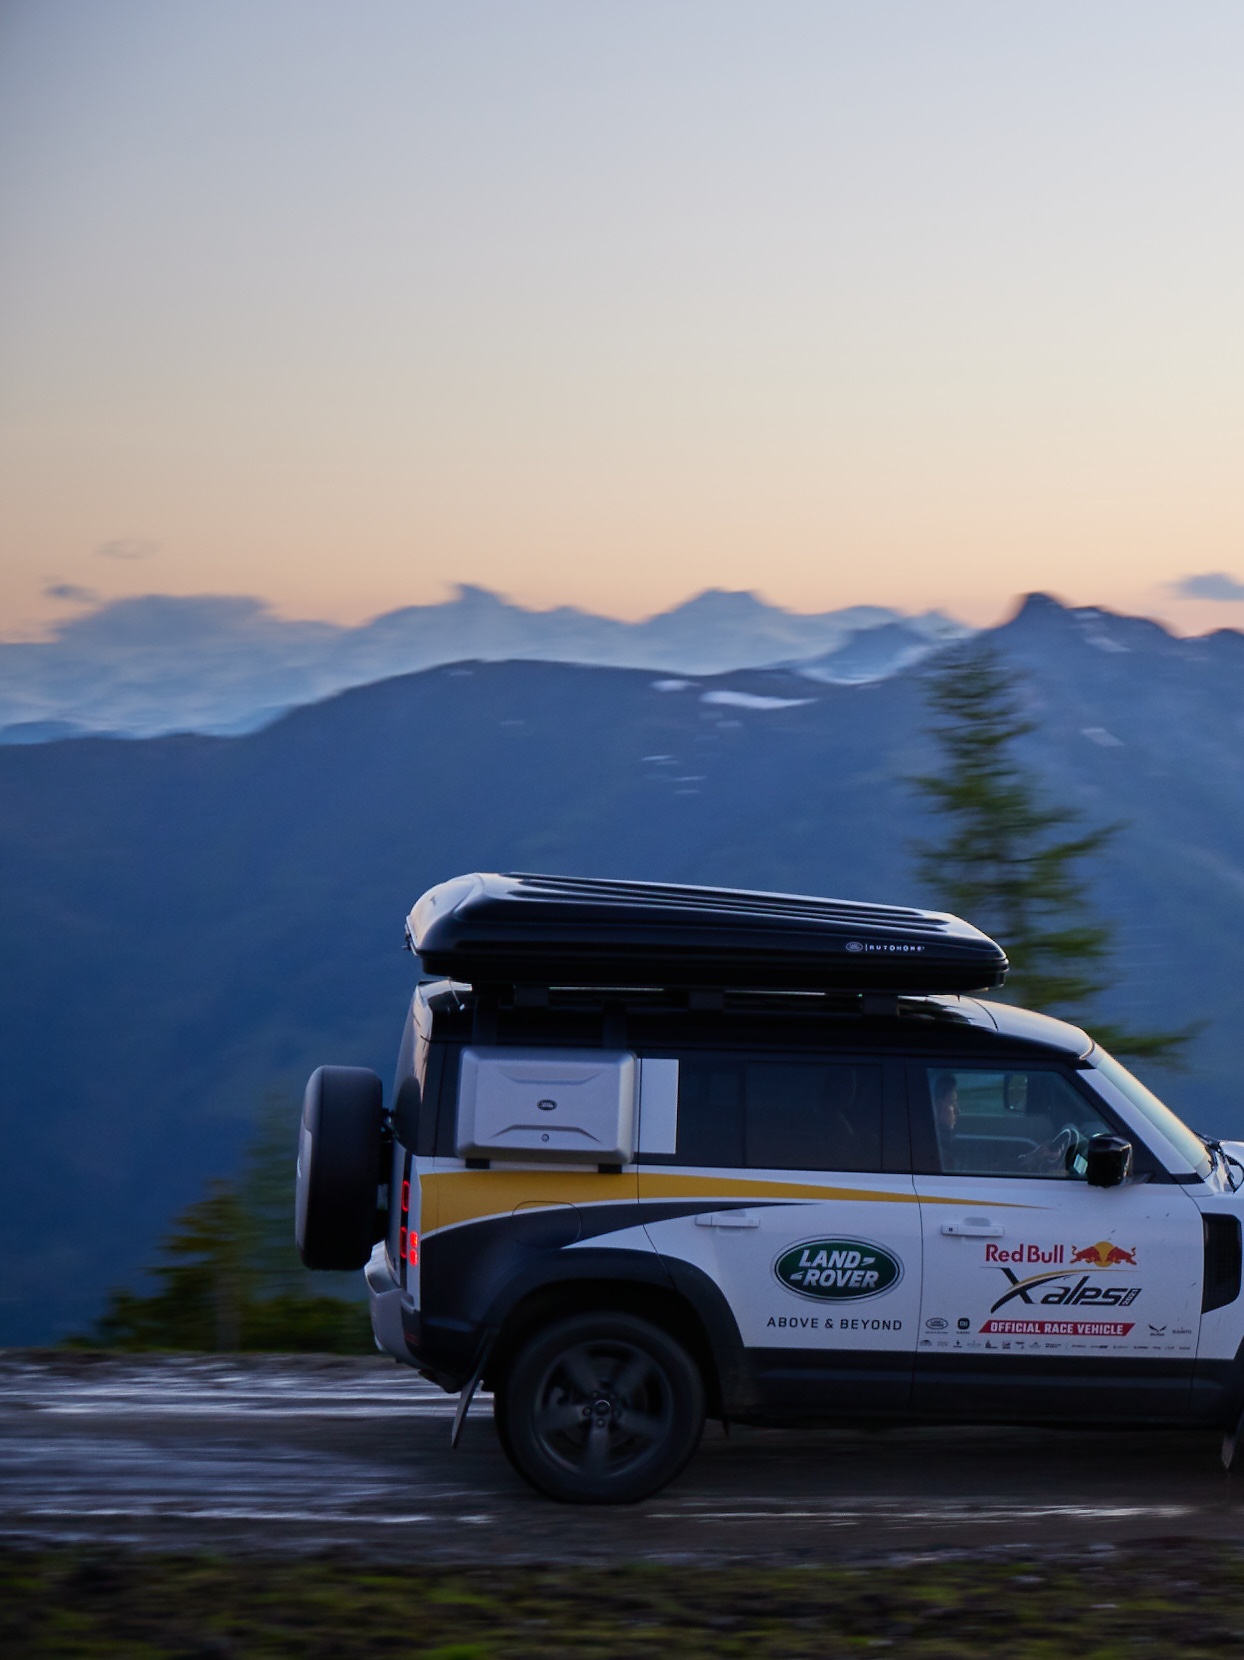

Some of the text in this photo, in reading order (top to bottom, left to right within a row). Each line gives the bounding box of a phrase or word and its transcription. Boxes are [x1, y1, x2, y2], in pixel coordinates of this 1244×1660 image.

[799, 1250, 861, 1268] LAND
[986, 1243, 1064, 1264] Red Bull
[803, 1269, 879, 1288] ROVER
[767, 1317, 902, 1330] ABOVE & BEYOND
[990, 1322, 1123, 1335] OFFICIAL RACE VEHICLE
